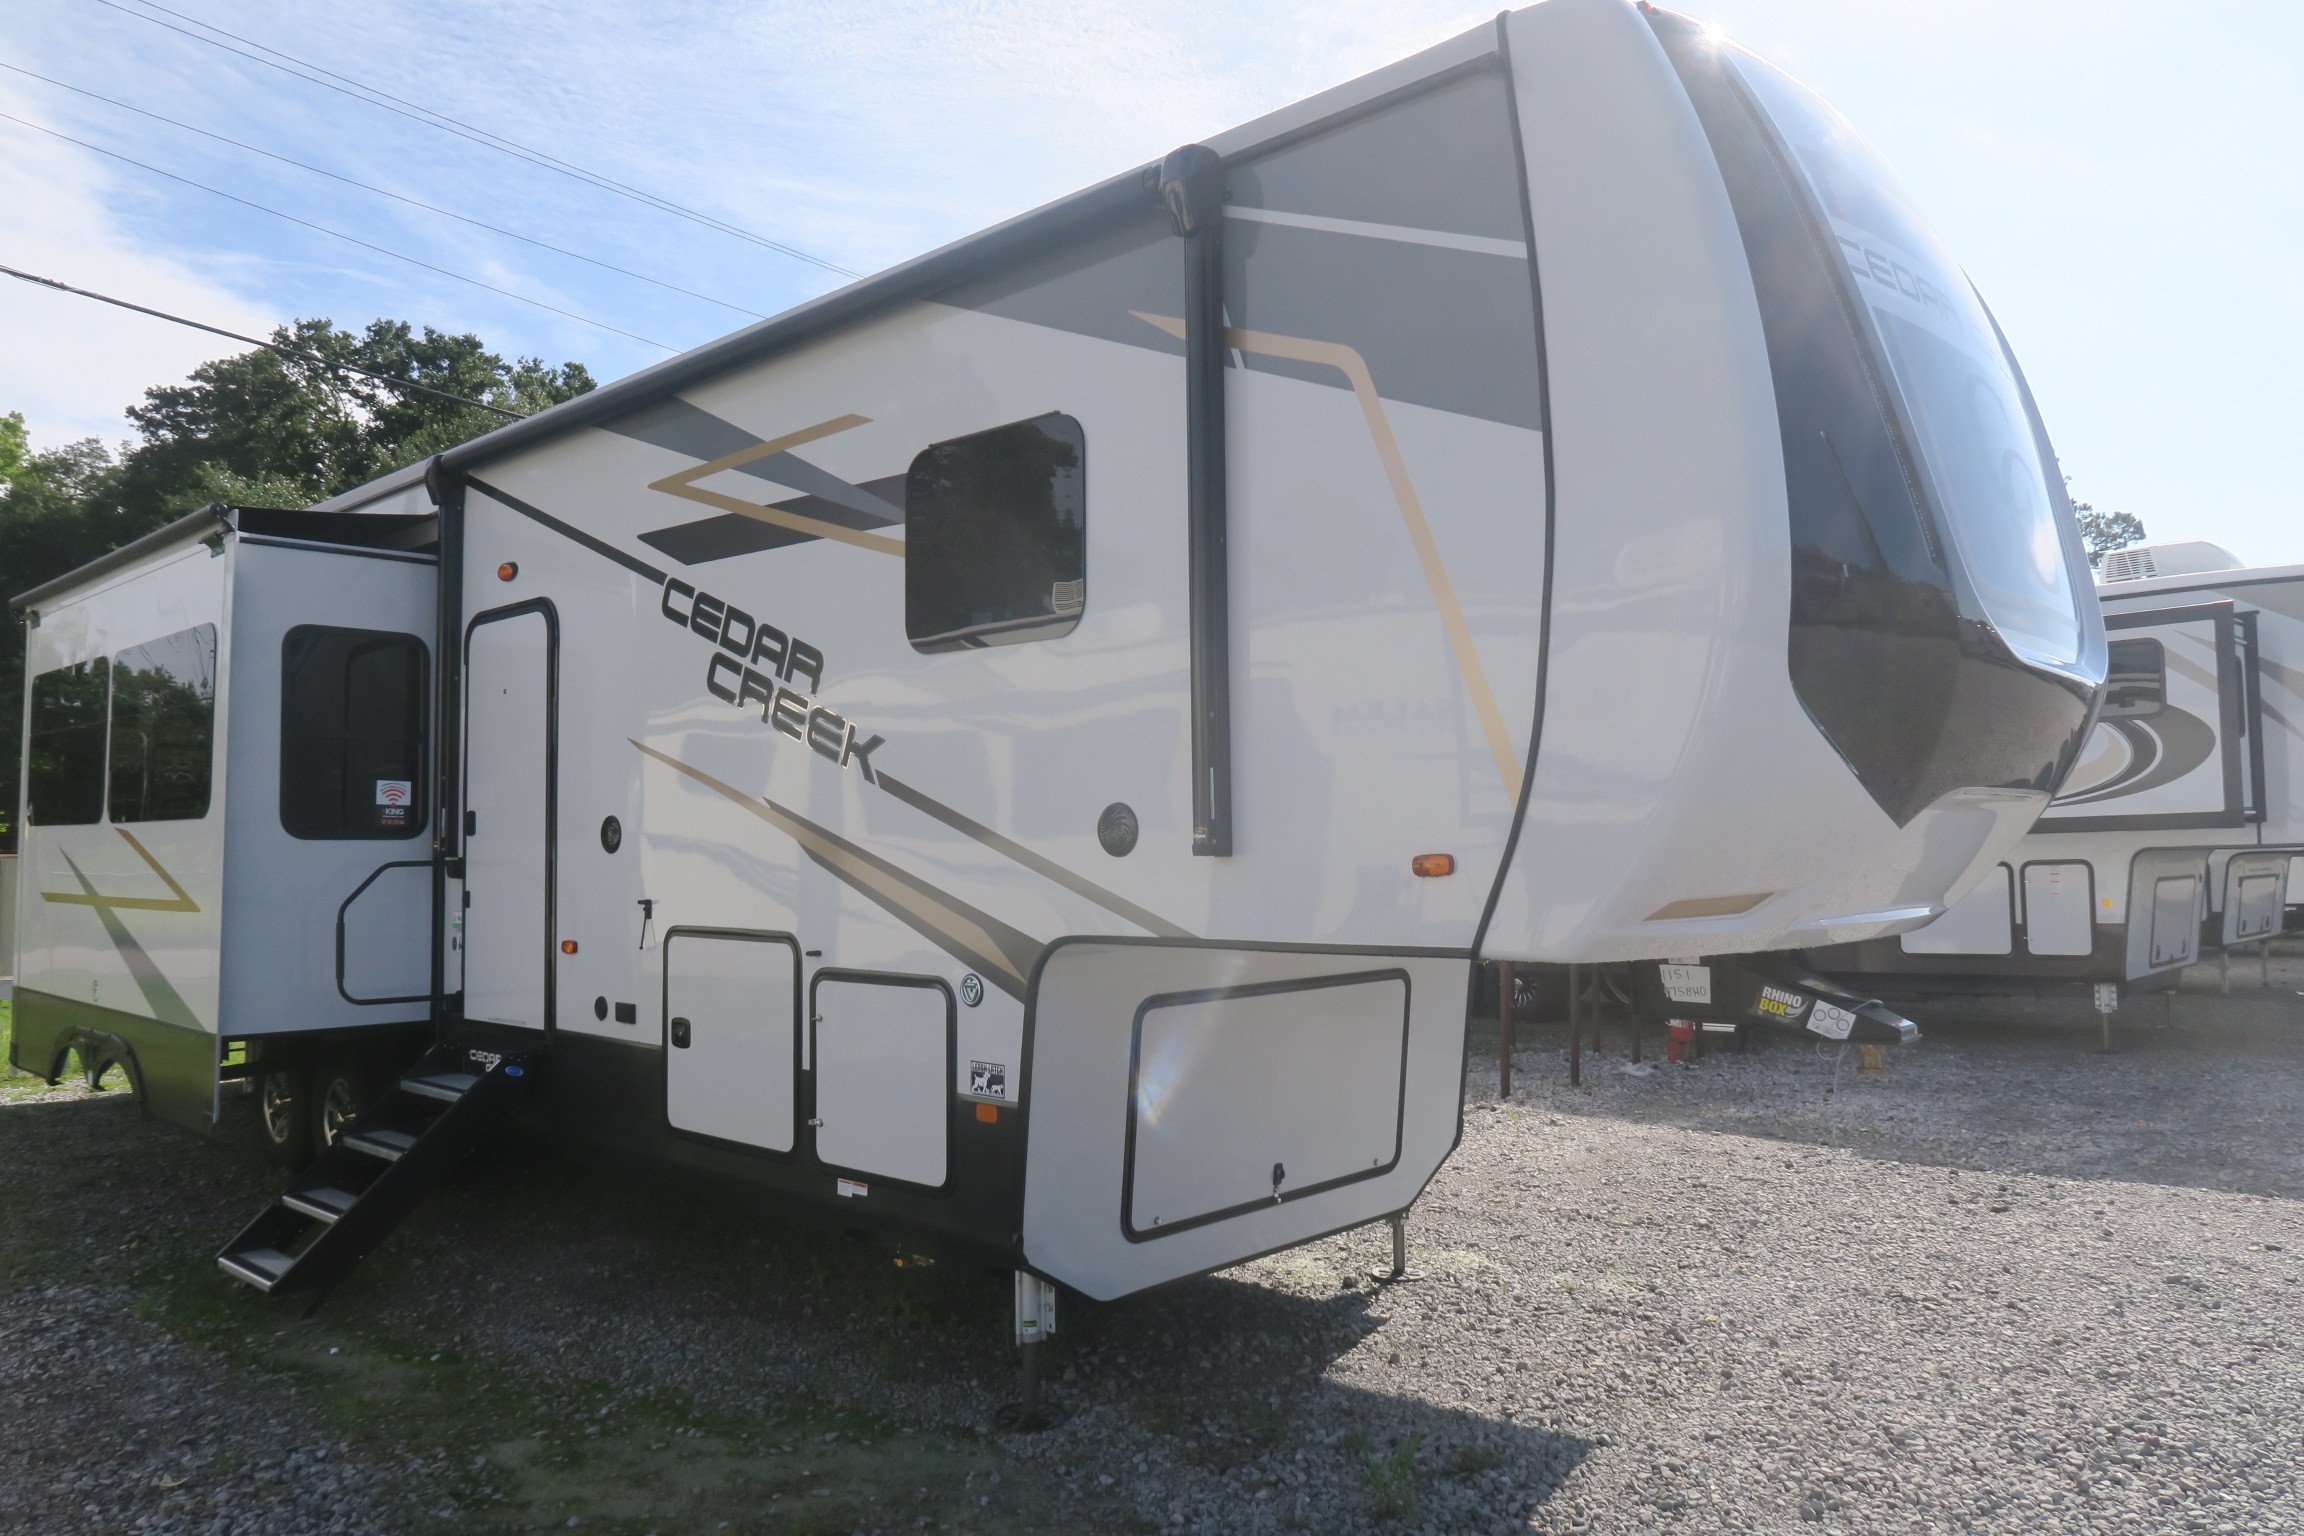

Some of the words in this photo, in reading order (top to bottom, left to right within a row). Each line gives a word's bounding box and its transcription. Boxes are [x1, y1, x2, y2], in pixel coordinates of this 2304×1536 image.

[660, 576, 825, 696] CEDAR
[706, 651, 886, 785] CREEK
[1759, 998, 1787, 1016] BOX
[1762, 986, 1801, 1008] RHINO
